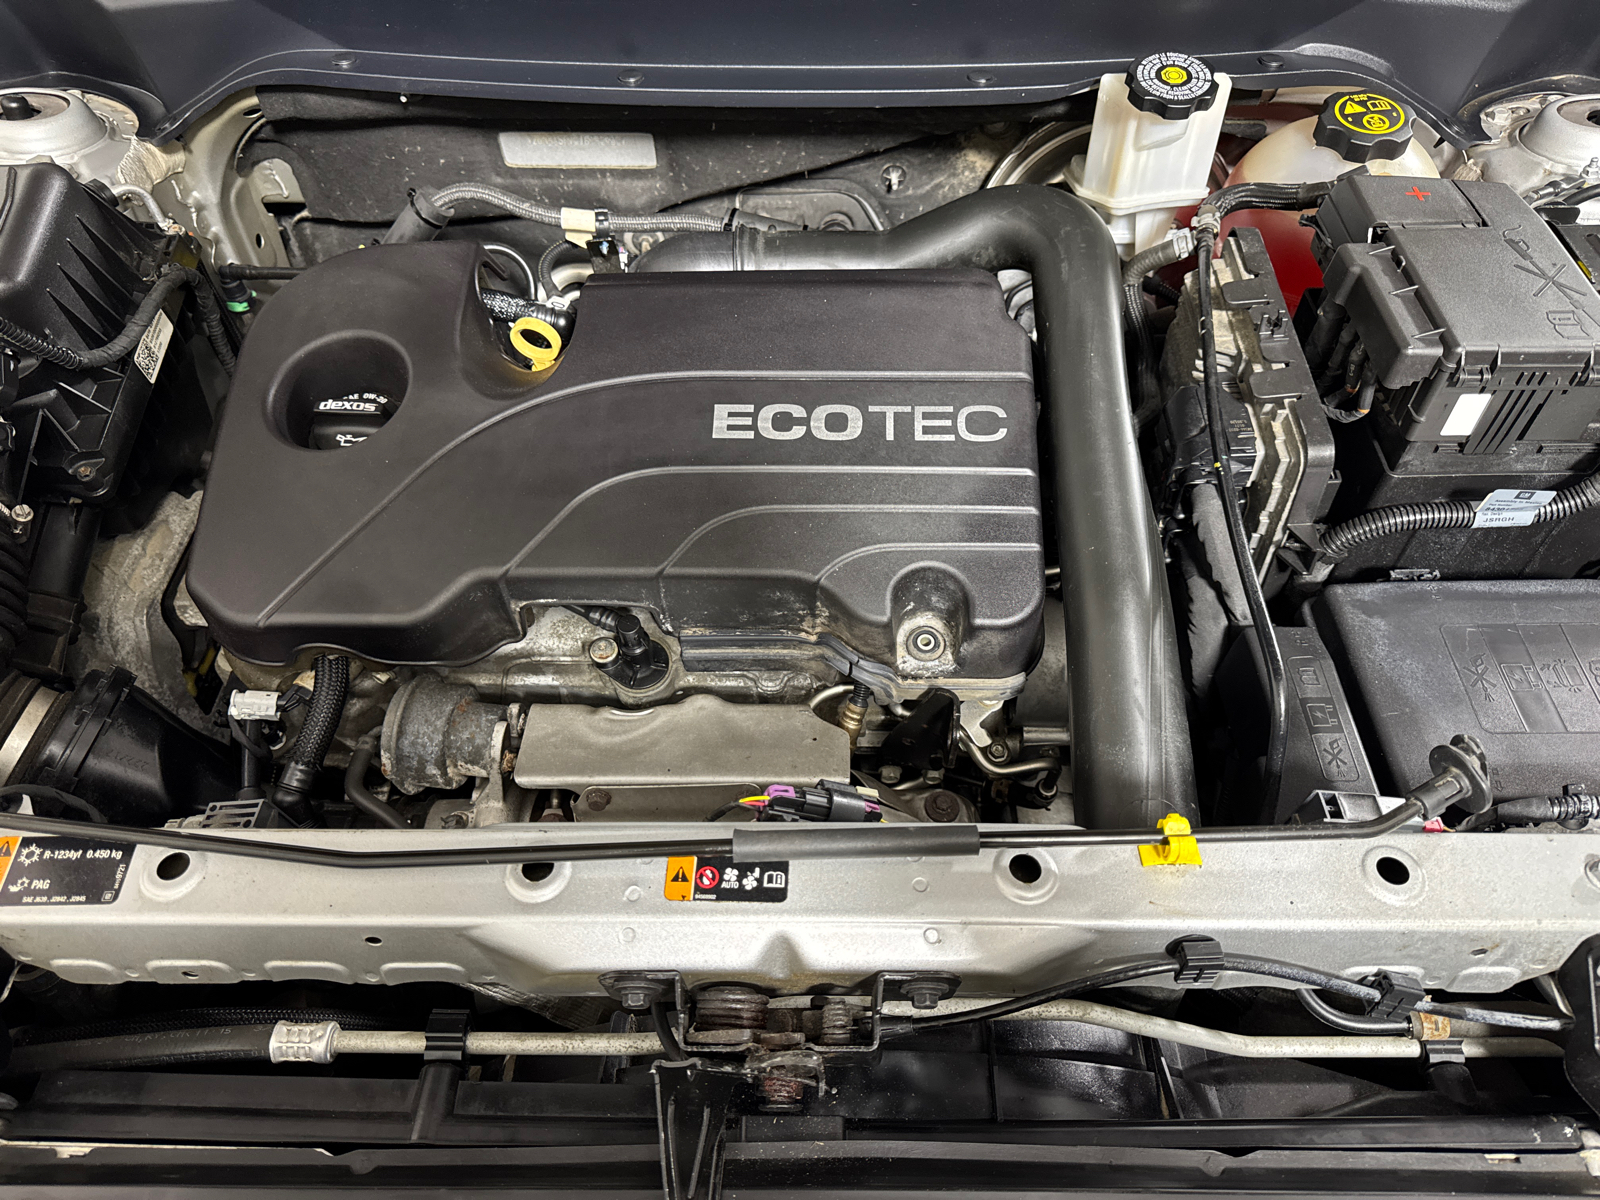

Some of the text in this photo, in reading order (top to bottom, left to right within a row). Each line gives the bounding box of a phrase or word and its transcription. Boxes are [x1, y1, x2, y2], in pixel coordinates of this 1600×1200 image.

[318, 399, 379, 412] dexos
[712, 403, 1008, 442] ECOTEC
[43, 848, 123, 861] R-1234yf 0.450 kg
[31, 879, 51, 889] PAG
[721, 881, 740, 889] AUTO
